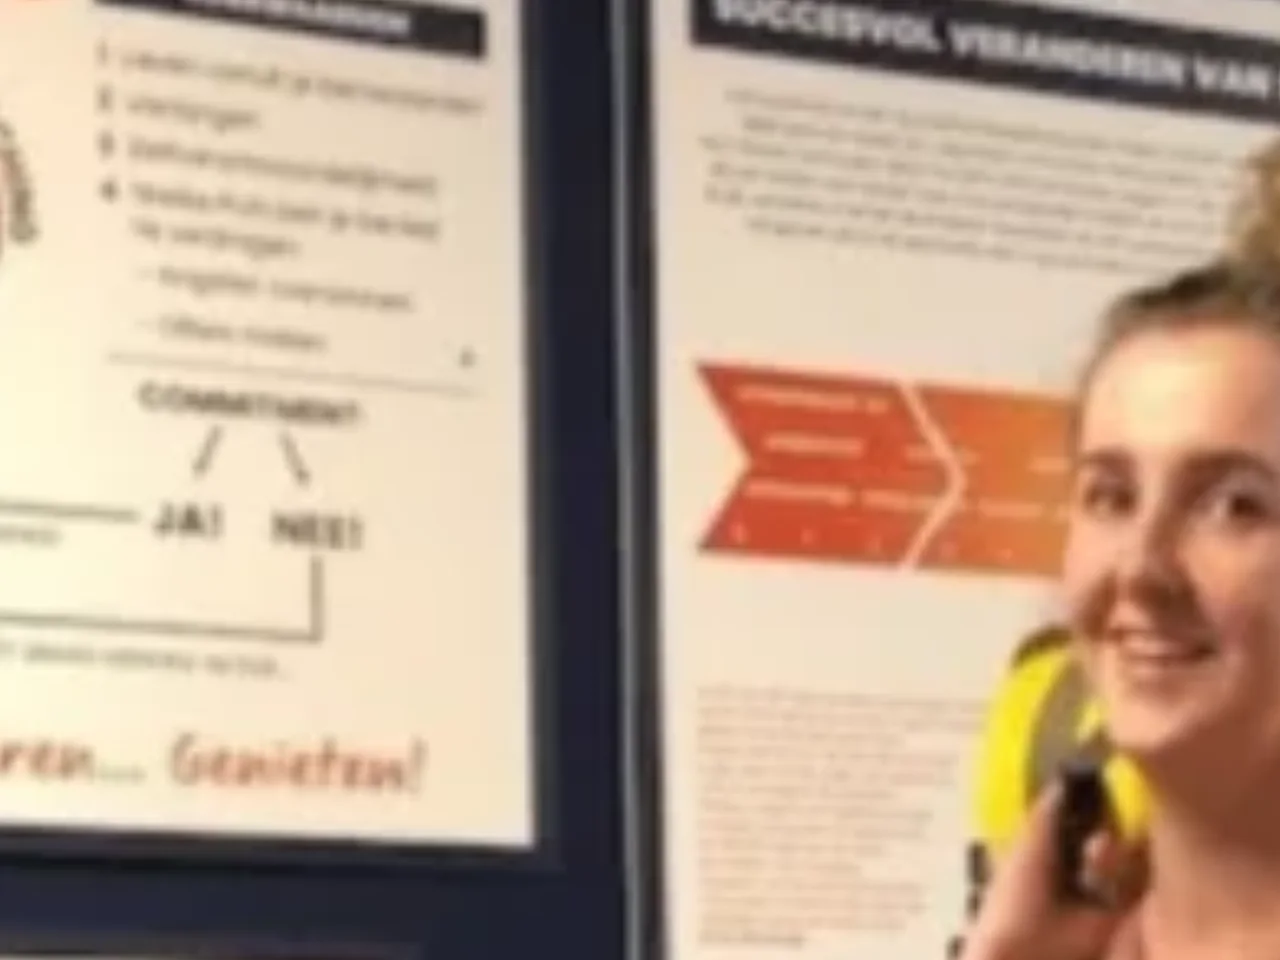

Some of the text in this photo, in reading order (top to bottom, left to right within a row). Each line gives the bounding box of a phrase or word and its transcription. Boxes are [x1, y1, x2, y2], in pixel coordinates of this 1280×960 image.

[714, 0, 941, 51] SUCCESVOL
[948, 23, 1185, 87] VERANDEREN
[1194, 59, 1271, 98] VAN
[136, 380, 364, 426] COMMITMENT
[152, 501, 365, 551] JA! NEE!
[168, 731, 428, 794] Genieten!
